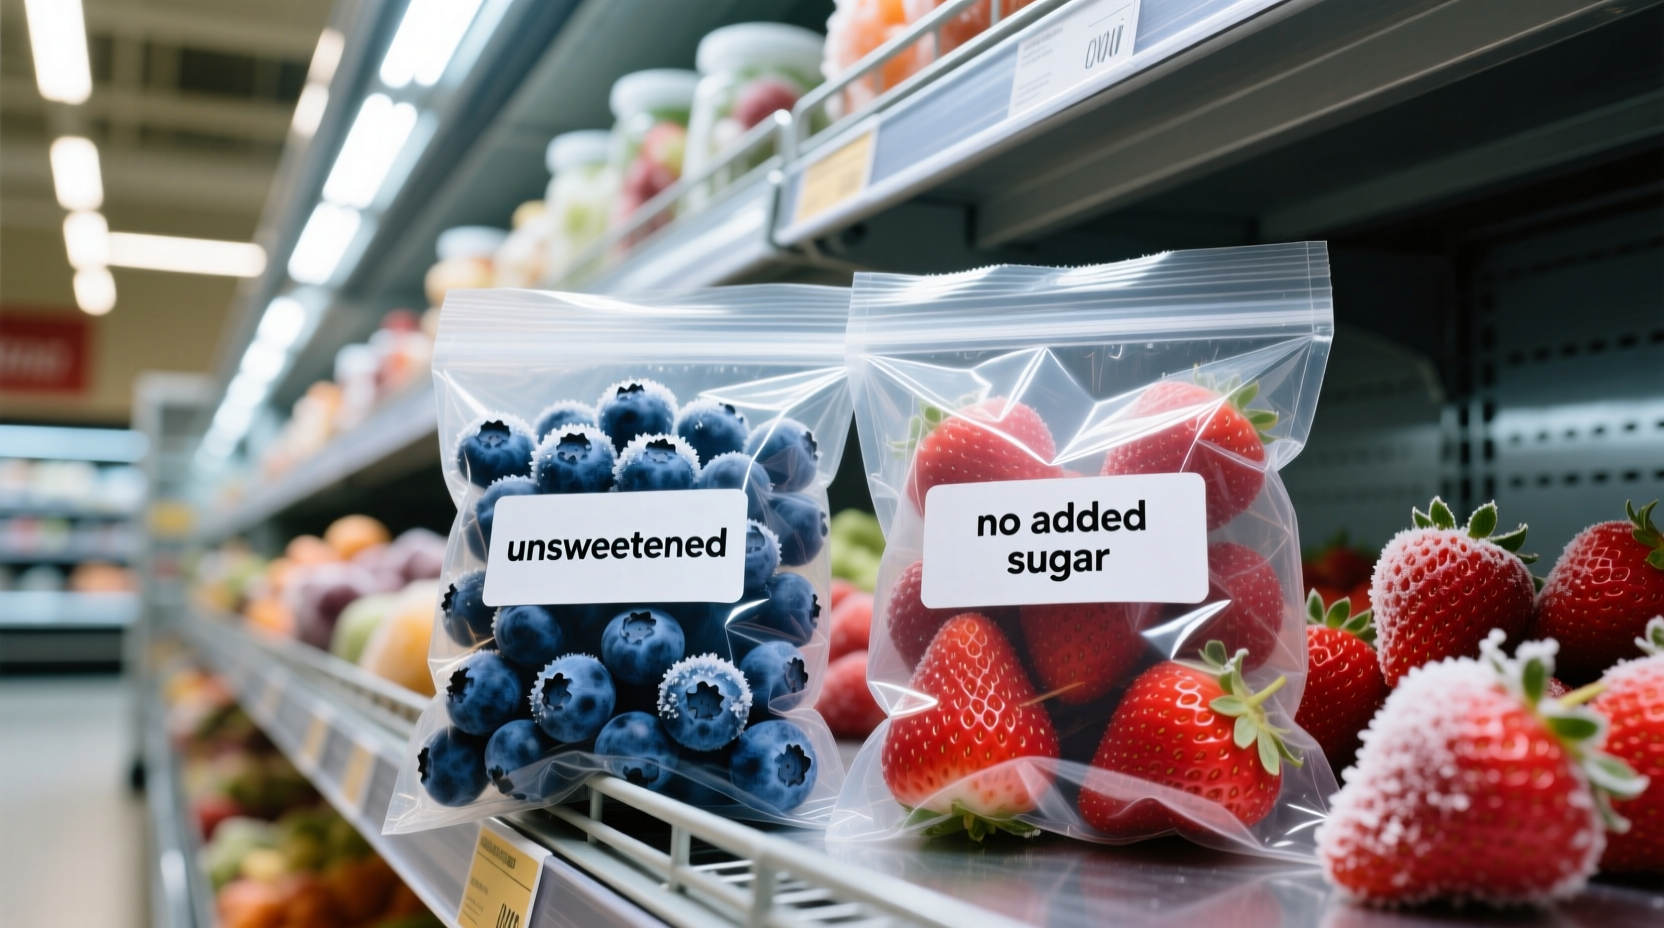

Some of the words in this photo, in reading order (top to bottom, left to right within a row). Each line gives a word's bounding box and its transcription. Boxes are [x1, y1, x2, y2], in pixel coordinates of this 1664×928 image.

[977, 512, 1021, 537] no
[1030, 499, 1146, 535] added
[507, 527, 728, 562] unsweetened
[1007, 548, 1111, 582] sugar
